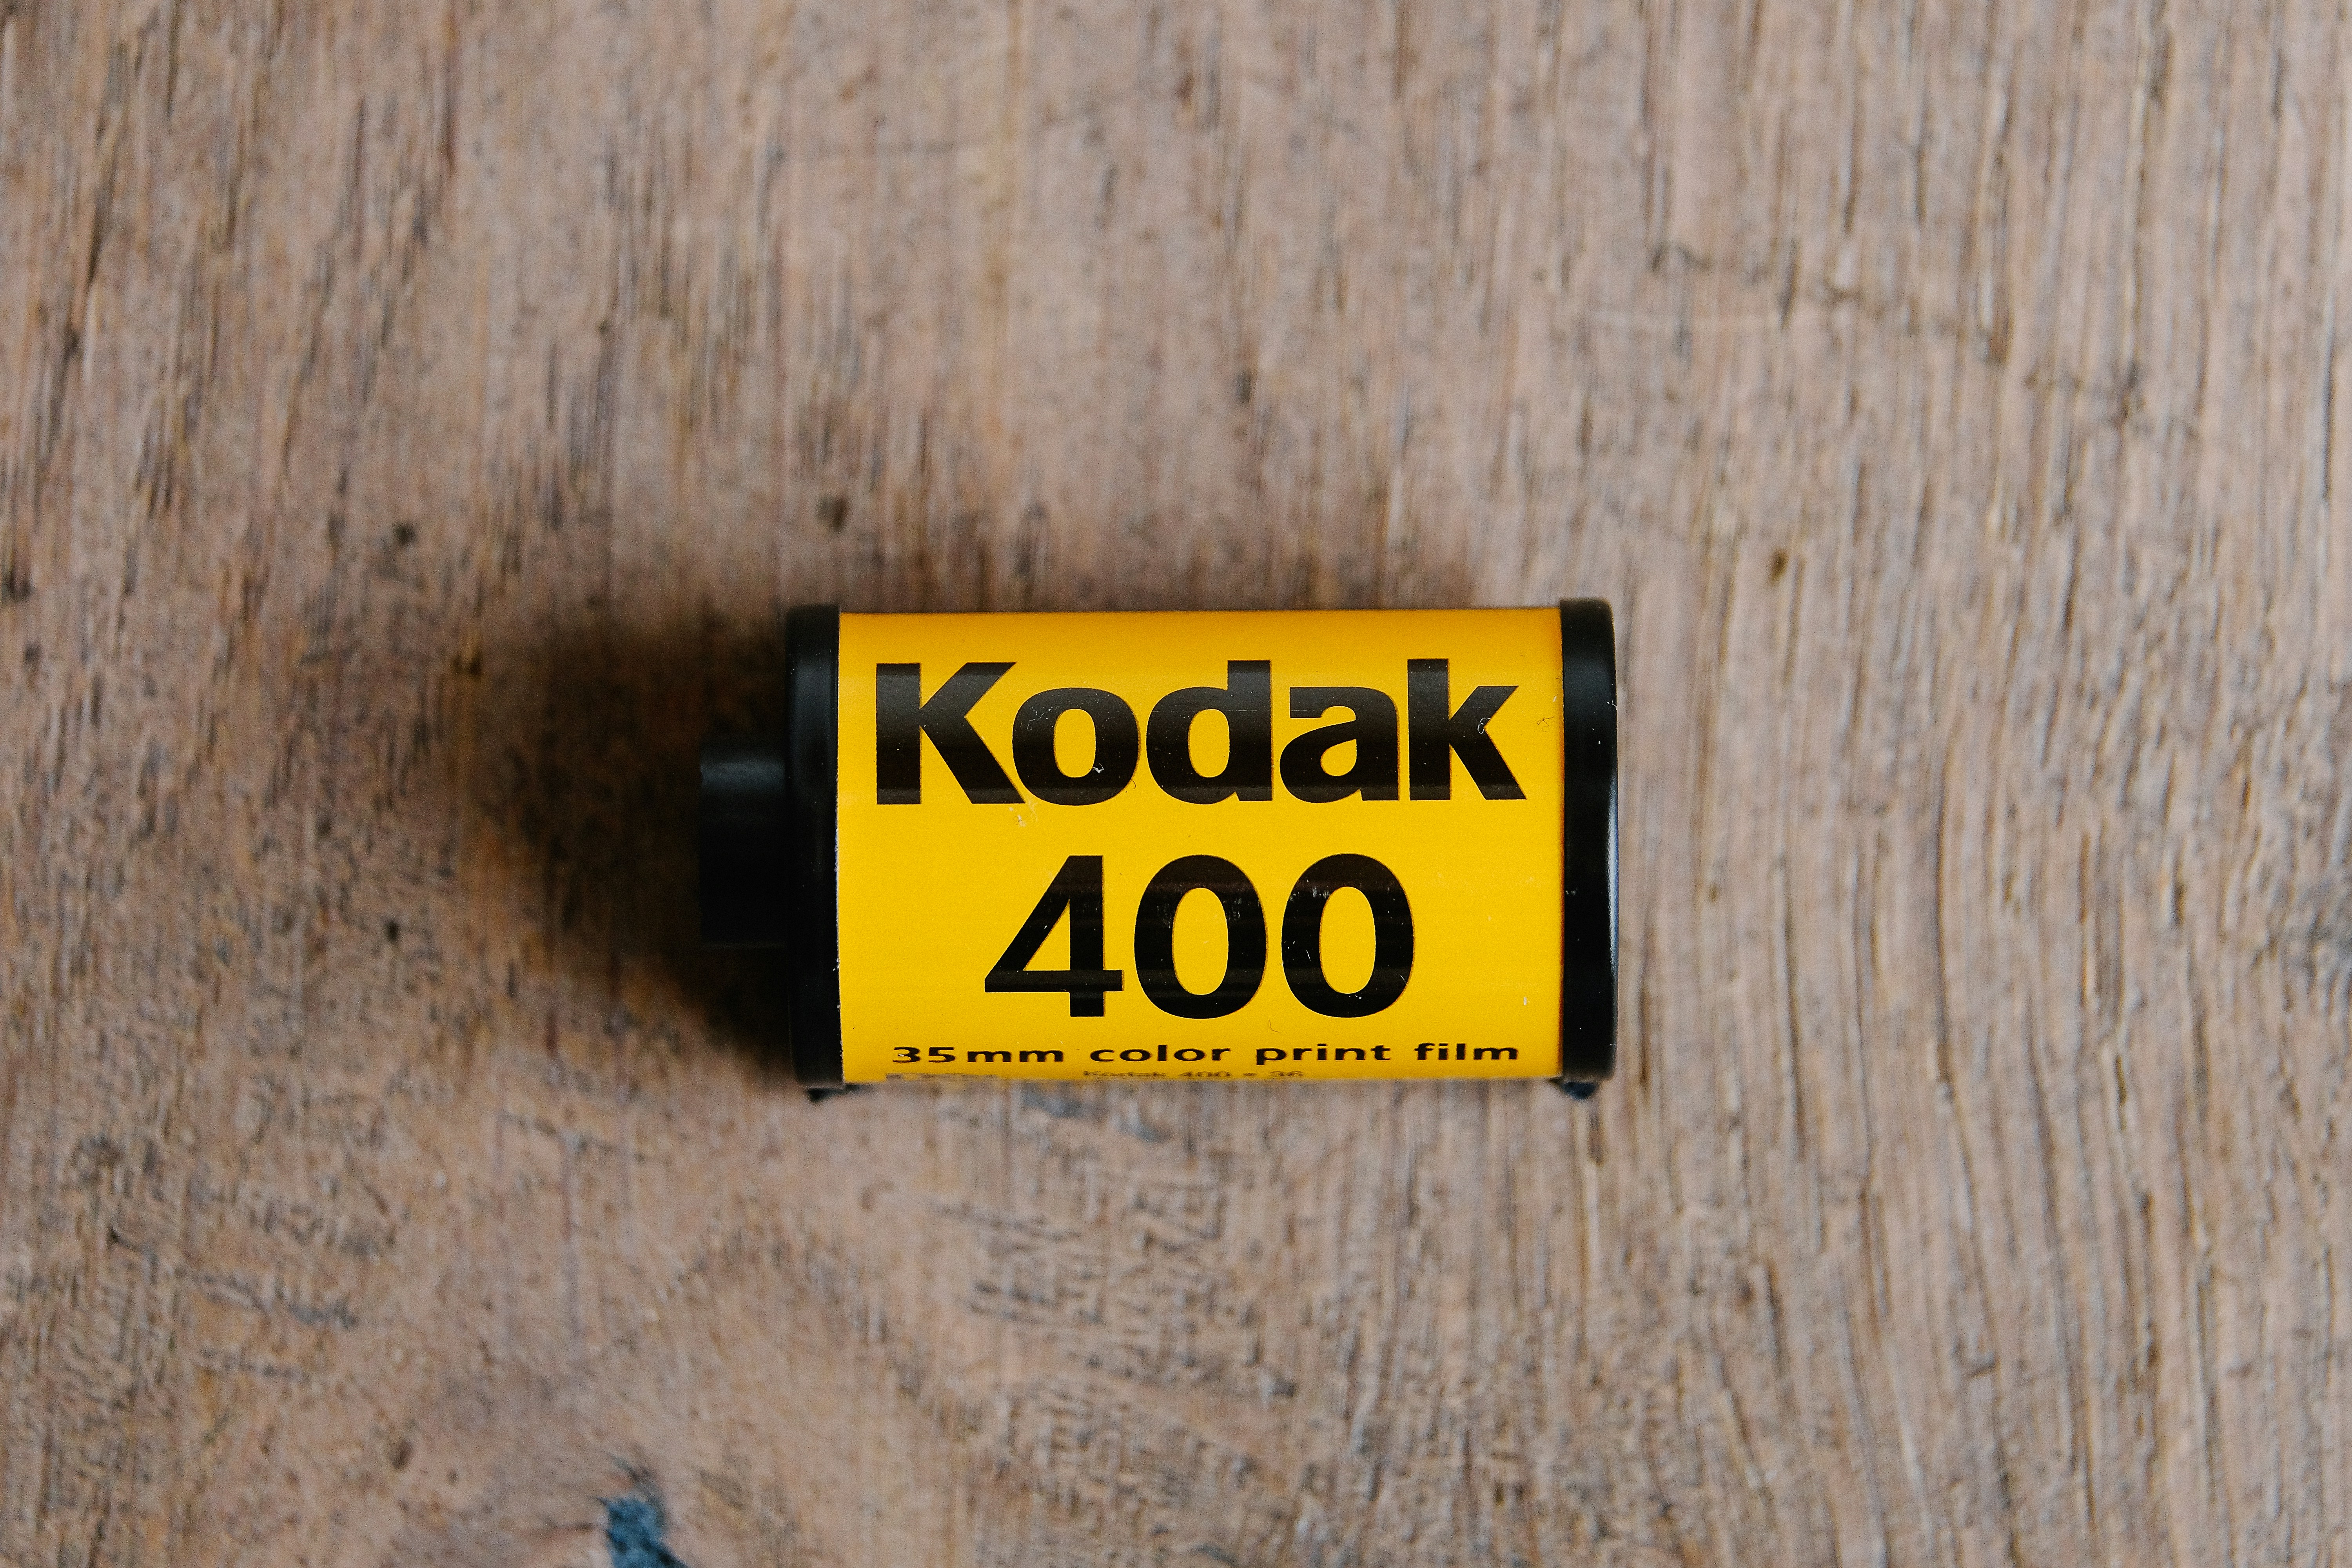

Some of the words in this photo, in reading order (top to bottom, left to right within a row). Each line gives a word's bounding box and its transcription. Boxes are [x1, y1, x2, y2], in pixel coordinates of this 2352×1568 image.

[876, 659, 1526, 806] Kodak
[984, 853, 1414, 1019] 400
[893, 1046, 1064, 1063] 35mm
[1090, 1044, 1231, 1062] color
[1256, 1043, 1391, 1065] print
[1414, 1042, 1518, 1061] film
